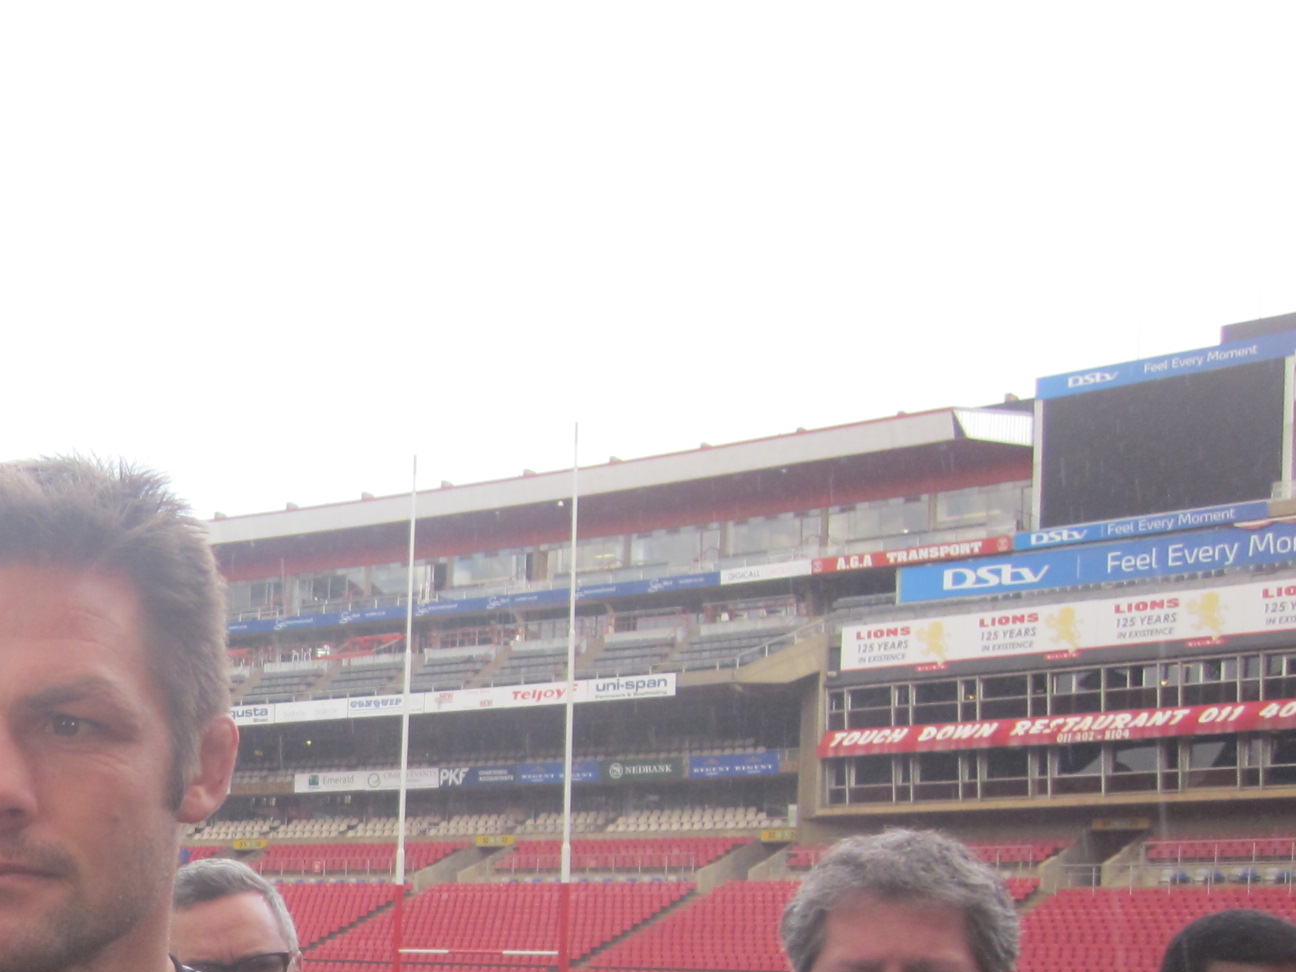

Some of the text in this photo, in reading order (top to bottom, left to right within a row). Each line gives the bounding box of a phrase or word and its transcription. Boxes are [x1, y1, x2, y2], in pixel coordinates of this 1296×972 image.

[1067, 345, 1258, 388] DStv Feel Every Moment
[1030, 508, 1236, 545] DStv Feel Every Moment
[836, 541, 982, 569] A.G.A TRANSPORT
[942, 564, 1050, 591] DStv
[1107, 549, 1157, 574] Feel
[1168, 541, 1238, 568] Every
[1114, 597, 1180, 614] LIONS
[979, 612, 1039, 628] LIONS
[1115, 612, 1177, 629] 125 YEARS
[856, 626, 911, 640] LIONS
[980, 626, 1037, 642] 125 YEARS
[1129, 626, 1175, 638] EXISTENCE
[856, 639, 909, 654] 125 YEARS
[992, 640, 1034, 651] EXISTENCE
[869, 652, 906, 663] EXISTENCE
[595, 677, 668, 693] uni-span
[829, 725, 909, 747] TOUCH
[916, 721, 998, 743] DOWN
[1009, 708, 1190, 736] RESTAURANT
[1198, 704, 1245, 723] 011
[1057, 732, 1072, 743] 011
[440, 768, 470, 786] PKF
[624, 763, 672, 775] NEDBANK
[322, 775, 354, 785] Emerald
